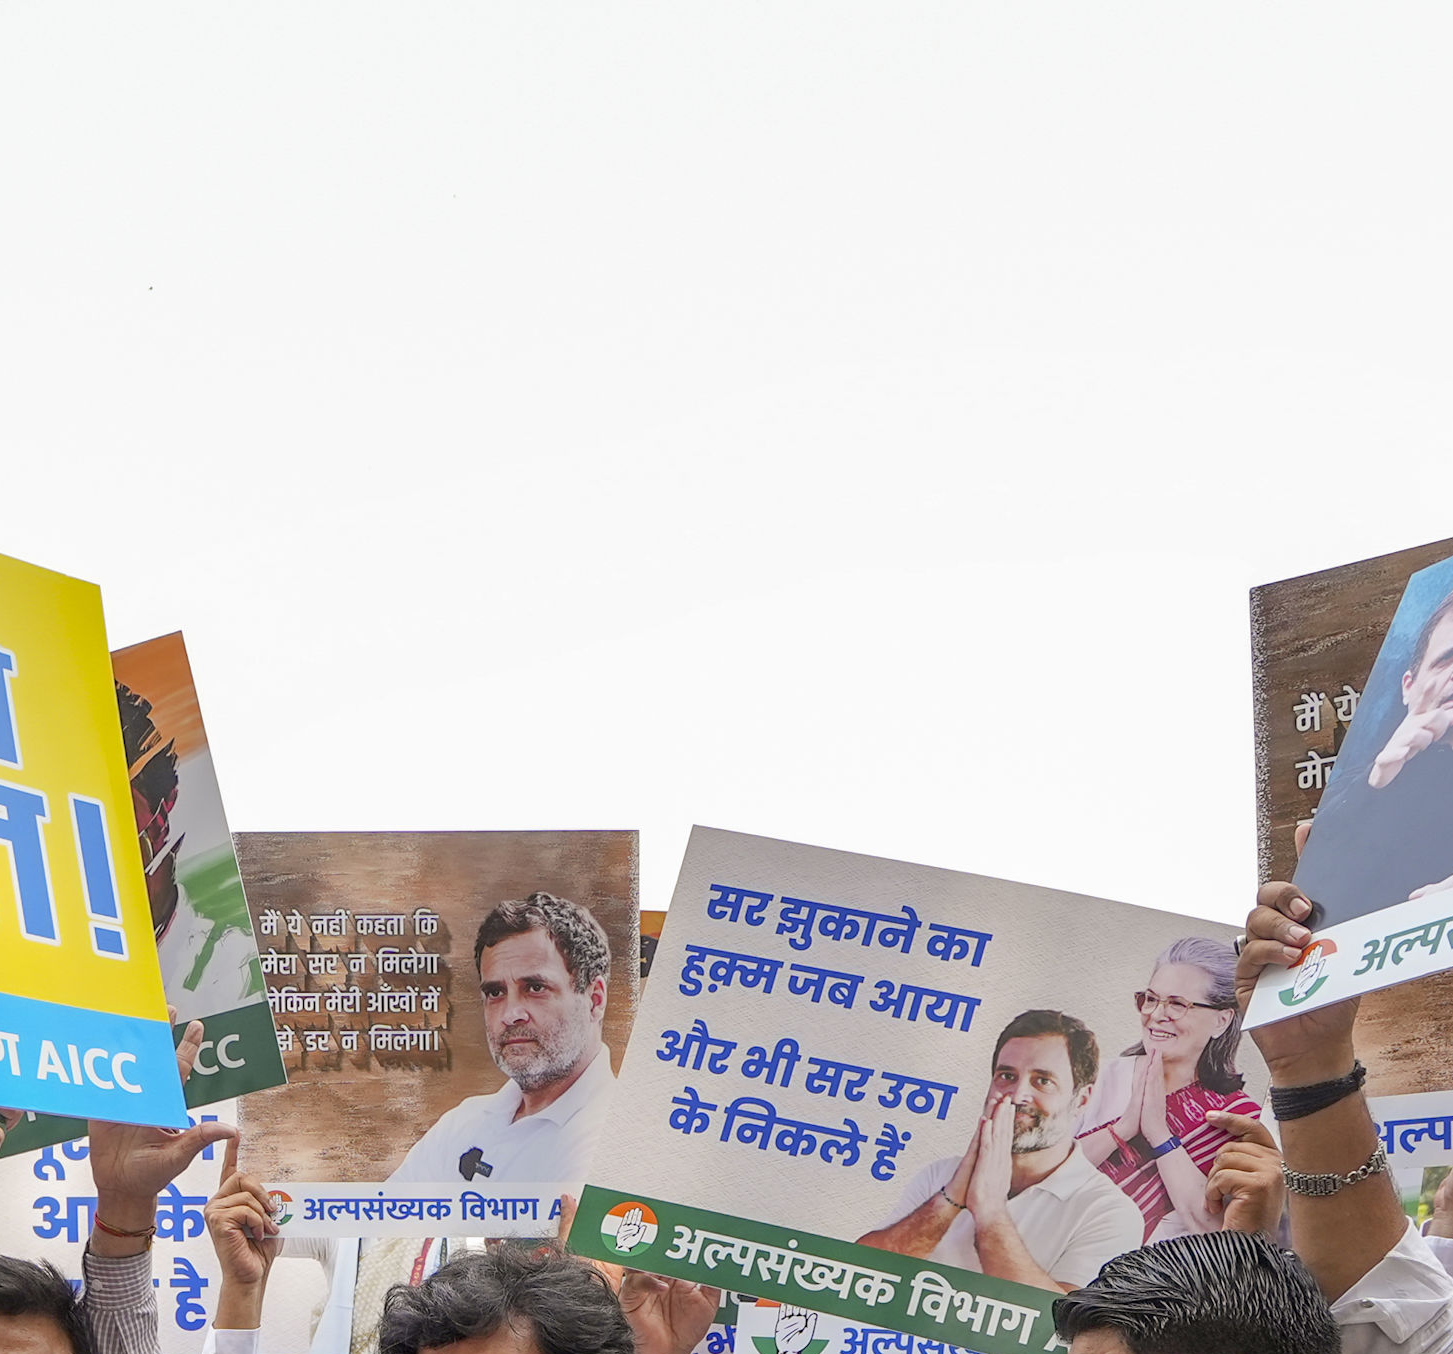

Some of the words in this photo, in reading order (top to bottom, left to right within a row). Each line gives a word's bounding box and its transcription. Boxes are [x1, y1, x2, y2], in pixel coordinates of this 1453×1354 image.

[1293, 692, 1326, 731] मैं
[259, 909, 281, 936] मैं
[287, 909, 303, 936] ये
[311, 909, 350, 936] नहीं
[356, 914, 406, 936] कहता
[413, 909, 439, 936] कि
[706, 883, 774, 927] सर
[775, 896, 922, 954] झुकाने
[926, 923, 993, 968] का
[260, 947, 298, 975] मेरा
[306, 954, 339, 975] सर
[348, 954, 367, 975] न
[376, 947, 440, 975] मिलेगा
[324, 986, 362, 1013] मेरी
[367, 982, 420, 1013] आँखों
[420, 986, 442, 1013] में
[788, 963, 864, 1009] जब
[869, 979, 982, 1033] आया
[303, 1030, 331, 1051] डर
[340, 1030, 359, 1051] न
[368, 1024, 440, 1051] मिलेगा।
[36, 1039, 143, 1094] AICC
[656, 1019, 737, 1075] और
[741, 1038, 801, 1088] भी
[805, 1057, 874, 1102] सर
[878, 1072, 959, 1121] उठा
[669, 1086, 718, 1135] के
[719, 1096, 868, 1167] निकले
[871, 1123, 912, 1182] हैं
[33, 1184, 208, 1243] आके
[303, 1191, 452, 1222] अल्पसंख्यक
[460, 1191, 539, 1221] विभाग
[170, 1257, 208, 1331] है
[665, 1224, 902, 1307] अल्पसंख्यक
[906, 1270, 1040, 1345] विभाग
